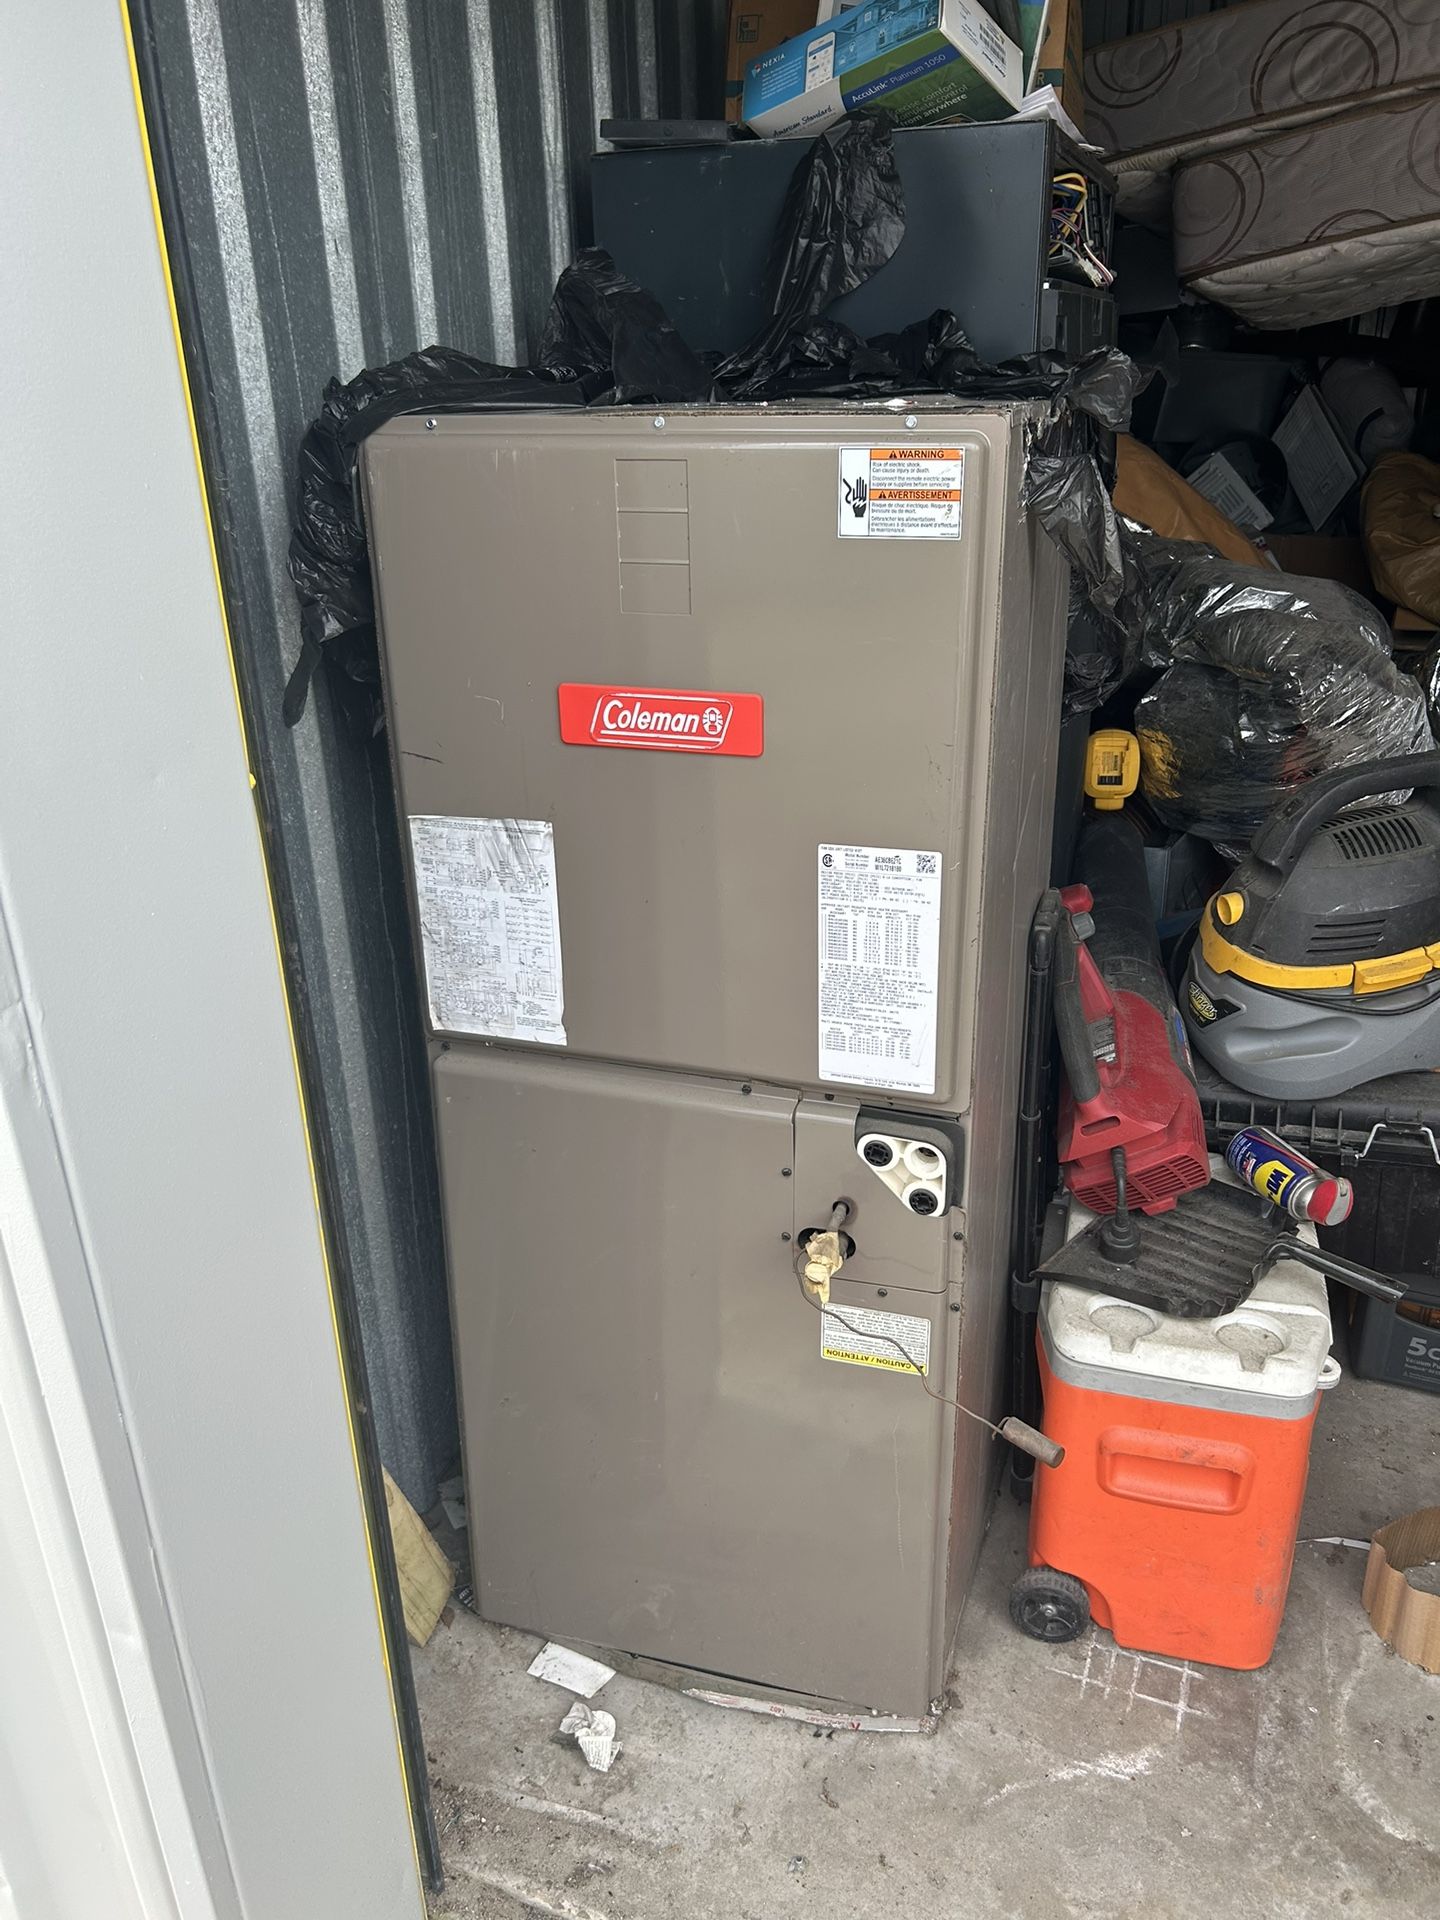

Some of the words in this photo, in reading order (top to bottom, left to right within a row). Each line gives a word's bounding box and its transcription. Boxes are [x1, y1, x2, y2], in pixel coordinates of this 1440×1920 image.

[762, 53, 785, 69] NEXIA
[890, 65, 925, 85] Platinum
[924, 54, 946, 68] 1050
[922, 82, 957, 101] comfort
[934, 84, 968, 106] control
[924, 93, 968, 118] anywhere
[773, 122, 801, 137] American
[801, 105, 833, 125] Standard
[898, 450, 944, 459] WARNING
[888, 491, 952, 499] AVERTISSEMENT
[602, 699, 700, 733] Coleman
[1190, 984, 1217, 1016] Stinger
[826, 1349, 870, 1362] ATTENTION
[876, 1357, 912, 1369] CAUTION
